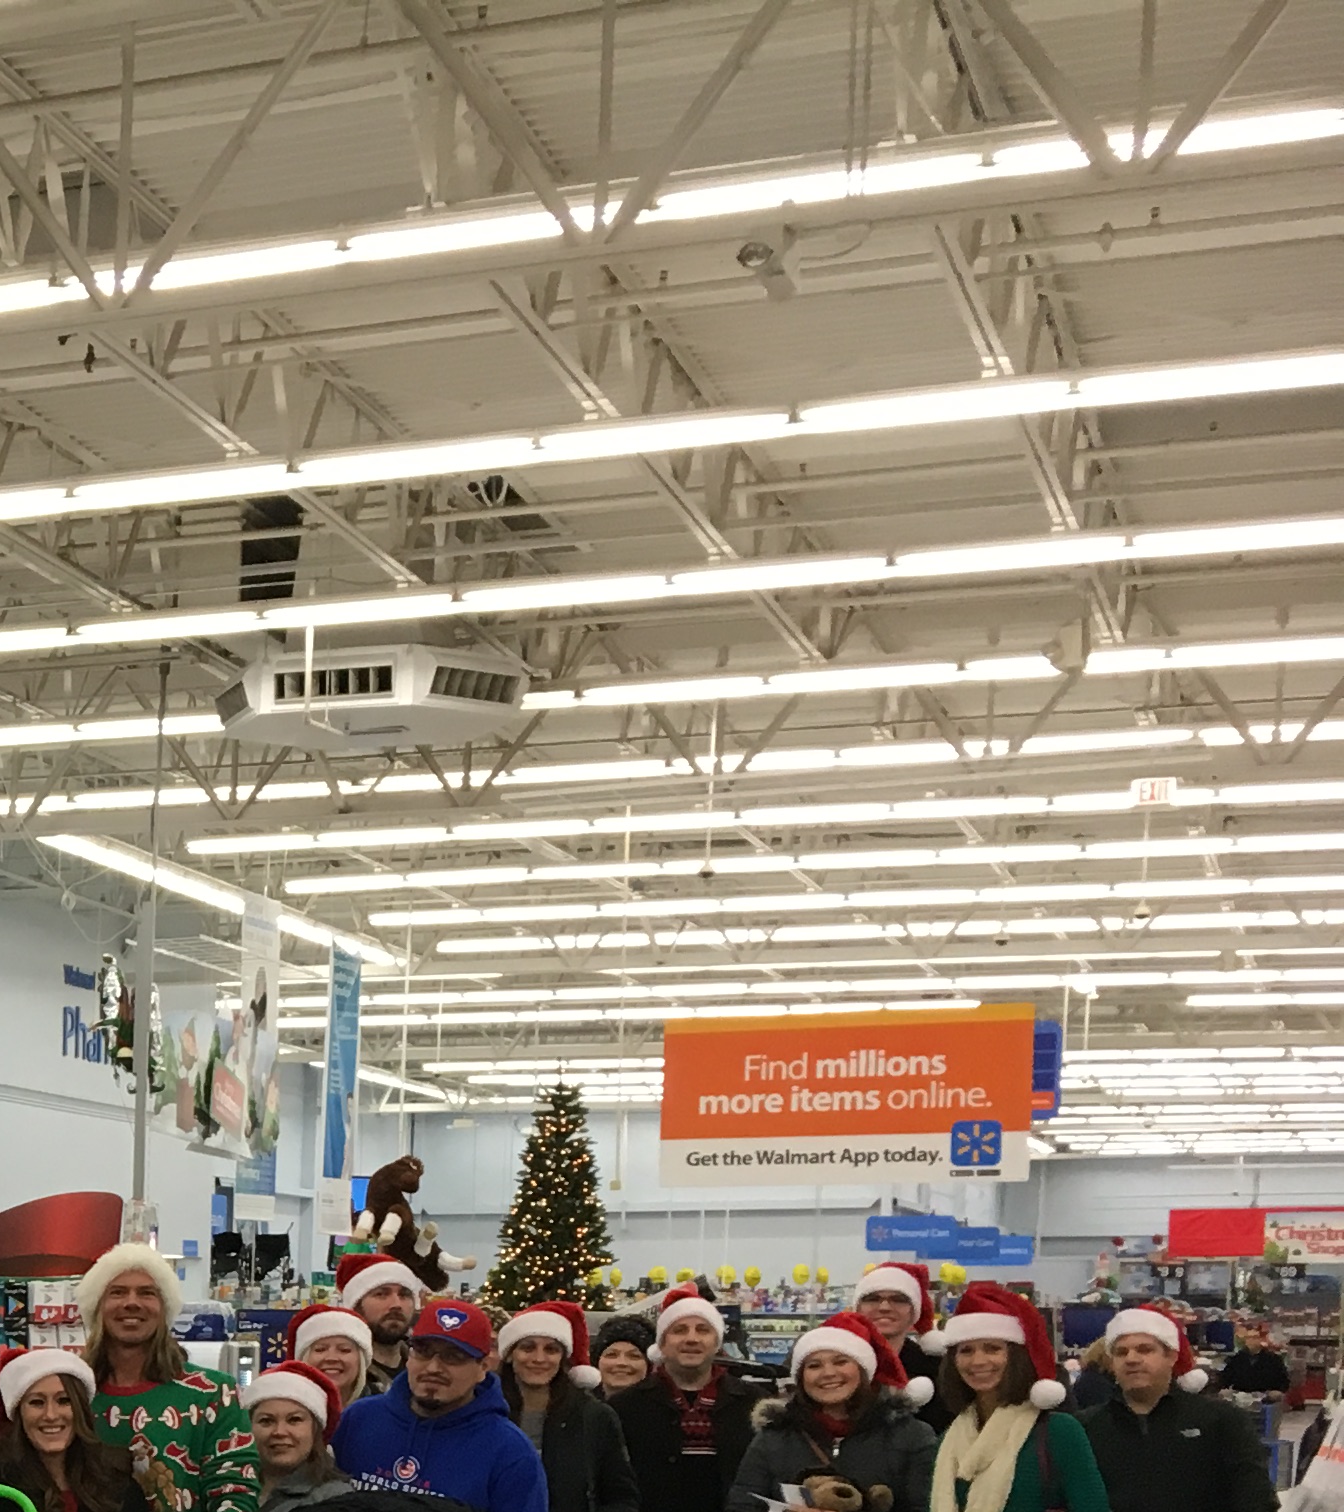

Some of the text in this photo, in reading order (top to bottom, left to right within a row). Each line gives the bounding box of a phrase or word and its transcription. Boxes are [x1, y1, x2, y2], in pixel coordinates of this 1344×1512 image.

[744, 1048, 948, 1082] Find millions
[698, 1079, 994, 1115] more items online.
[685, 1145, 944, 1168] Get the Walmart App today.
